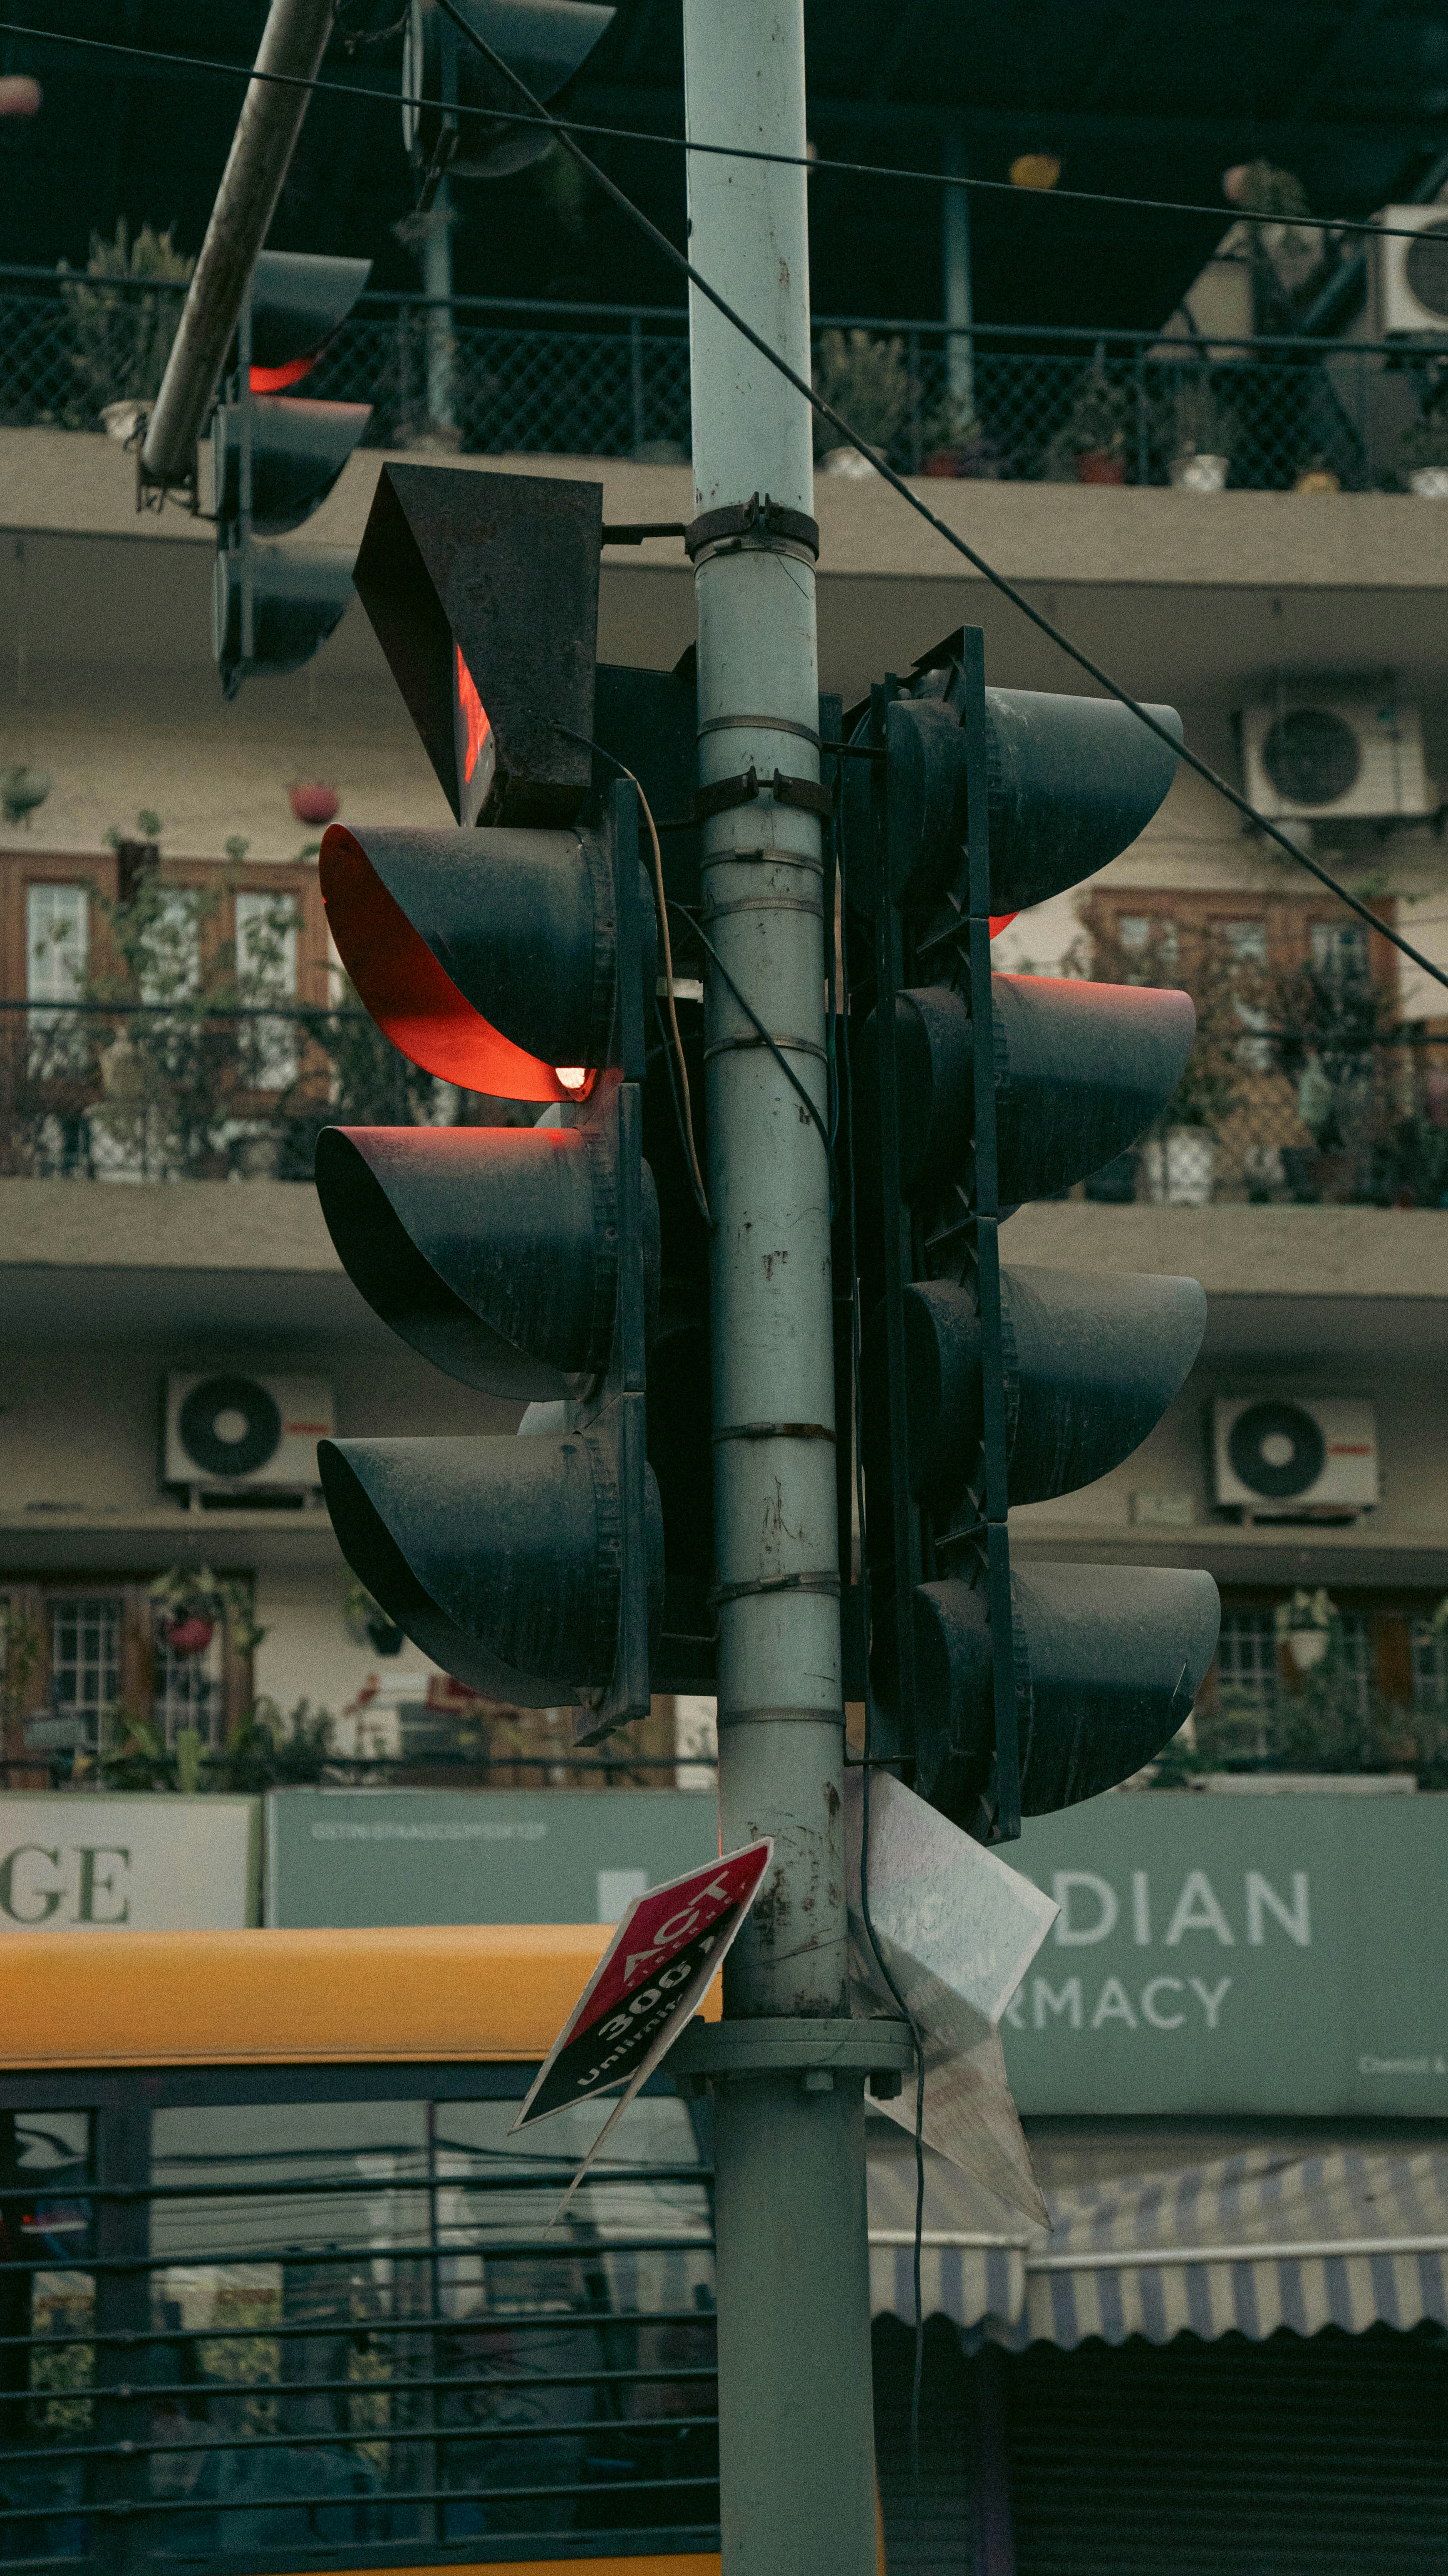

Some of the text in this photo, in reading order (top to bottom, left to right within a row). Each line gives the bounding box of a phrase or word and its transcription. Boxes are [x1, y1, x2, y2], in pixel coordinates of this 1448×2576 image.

[0, 1844, 131, 1925] GE
[624, 1870, 730, 1983] ACT
[578, 1994, 683, 2086] Unlimit
[598, 1959, 692, 2041] 300
